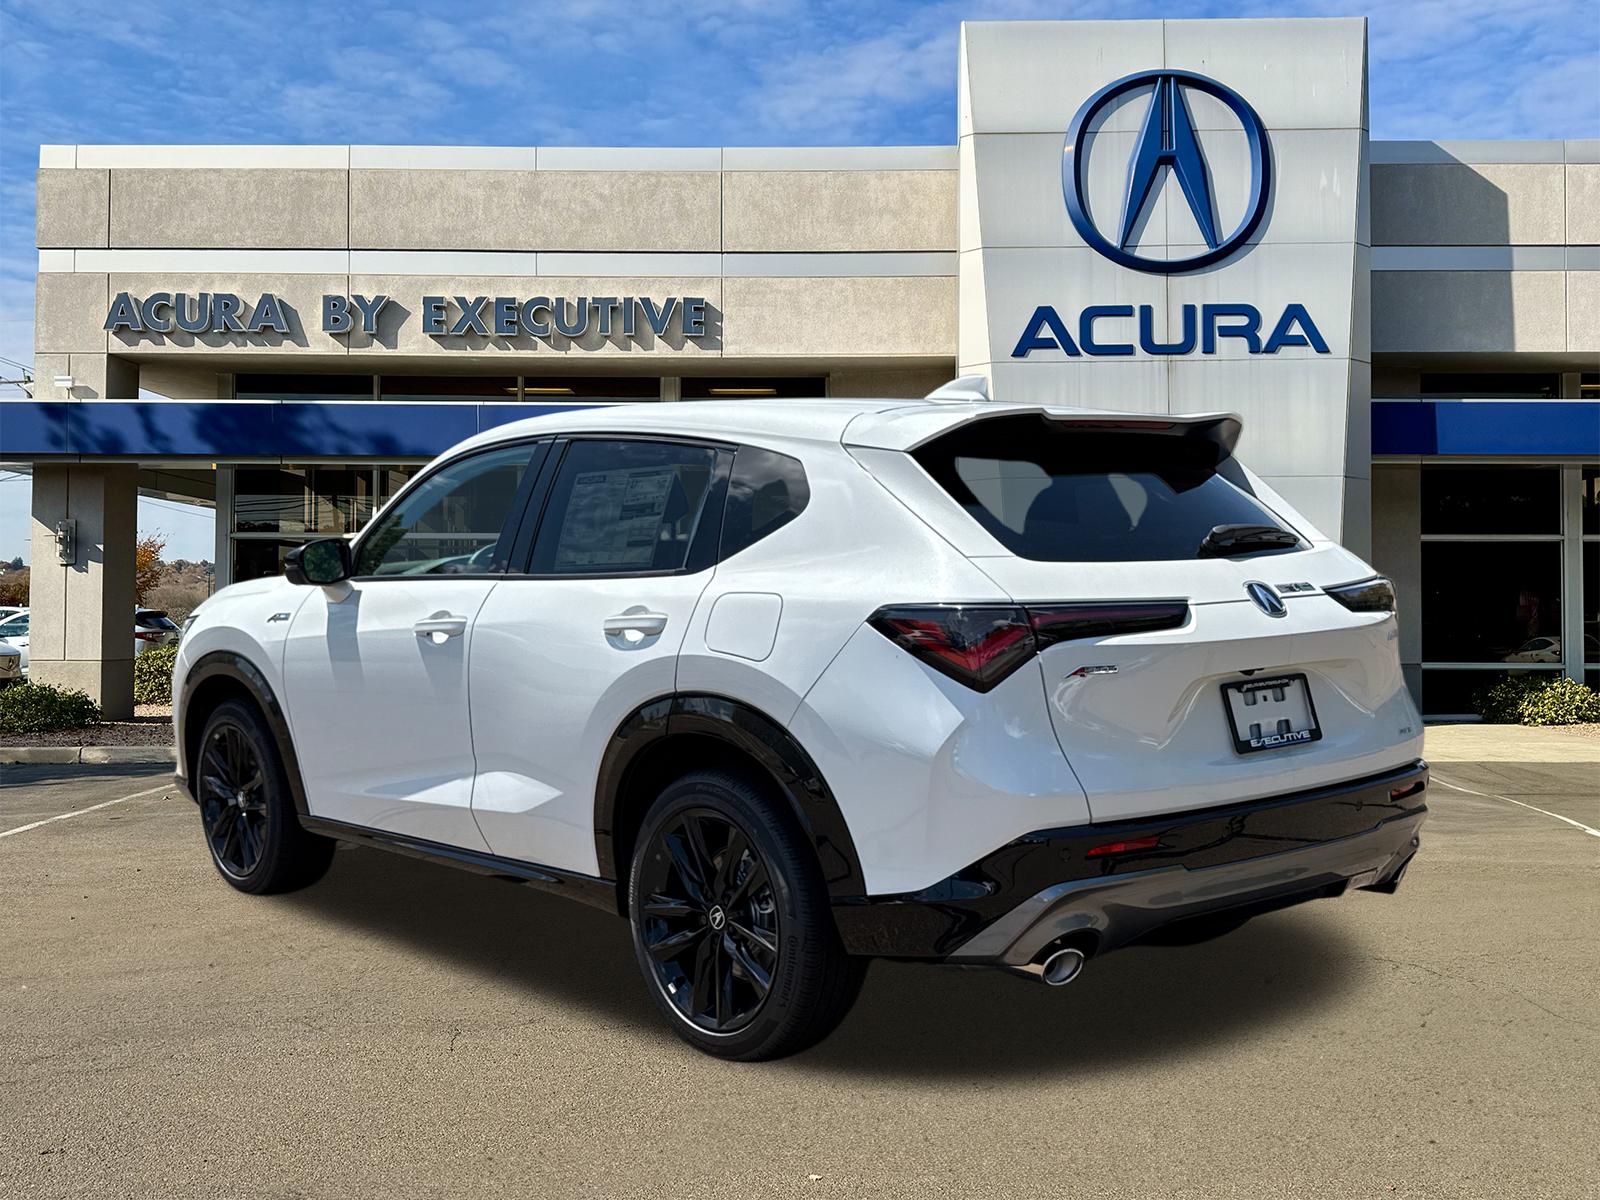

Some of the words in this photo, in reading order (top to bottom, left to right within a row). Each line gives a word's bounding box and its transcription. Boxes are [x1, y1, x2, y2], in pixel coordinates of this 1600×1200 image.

[104, 291, 290, 334] ACURA
[322, 294, 391, 334] BY
[422, 296, 706, 336] EXECUTIVE
[1011, 303, 1332, 357] ACURA
[1250, 730, 1311, 748] EXECUTIVE
